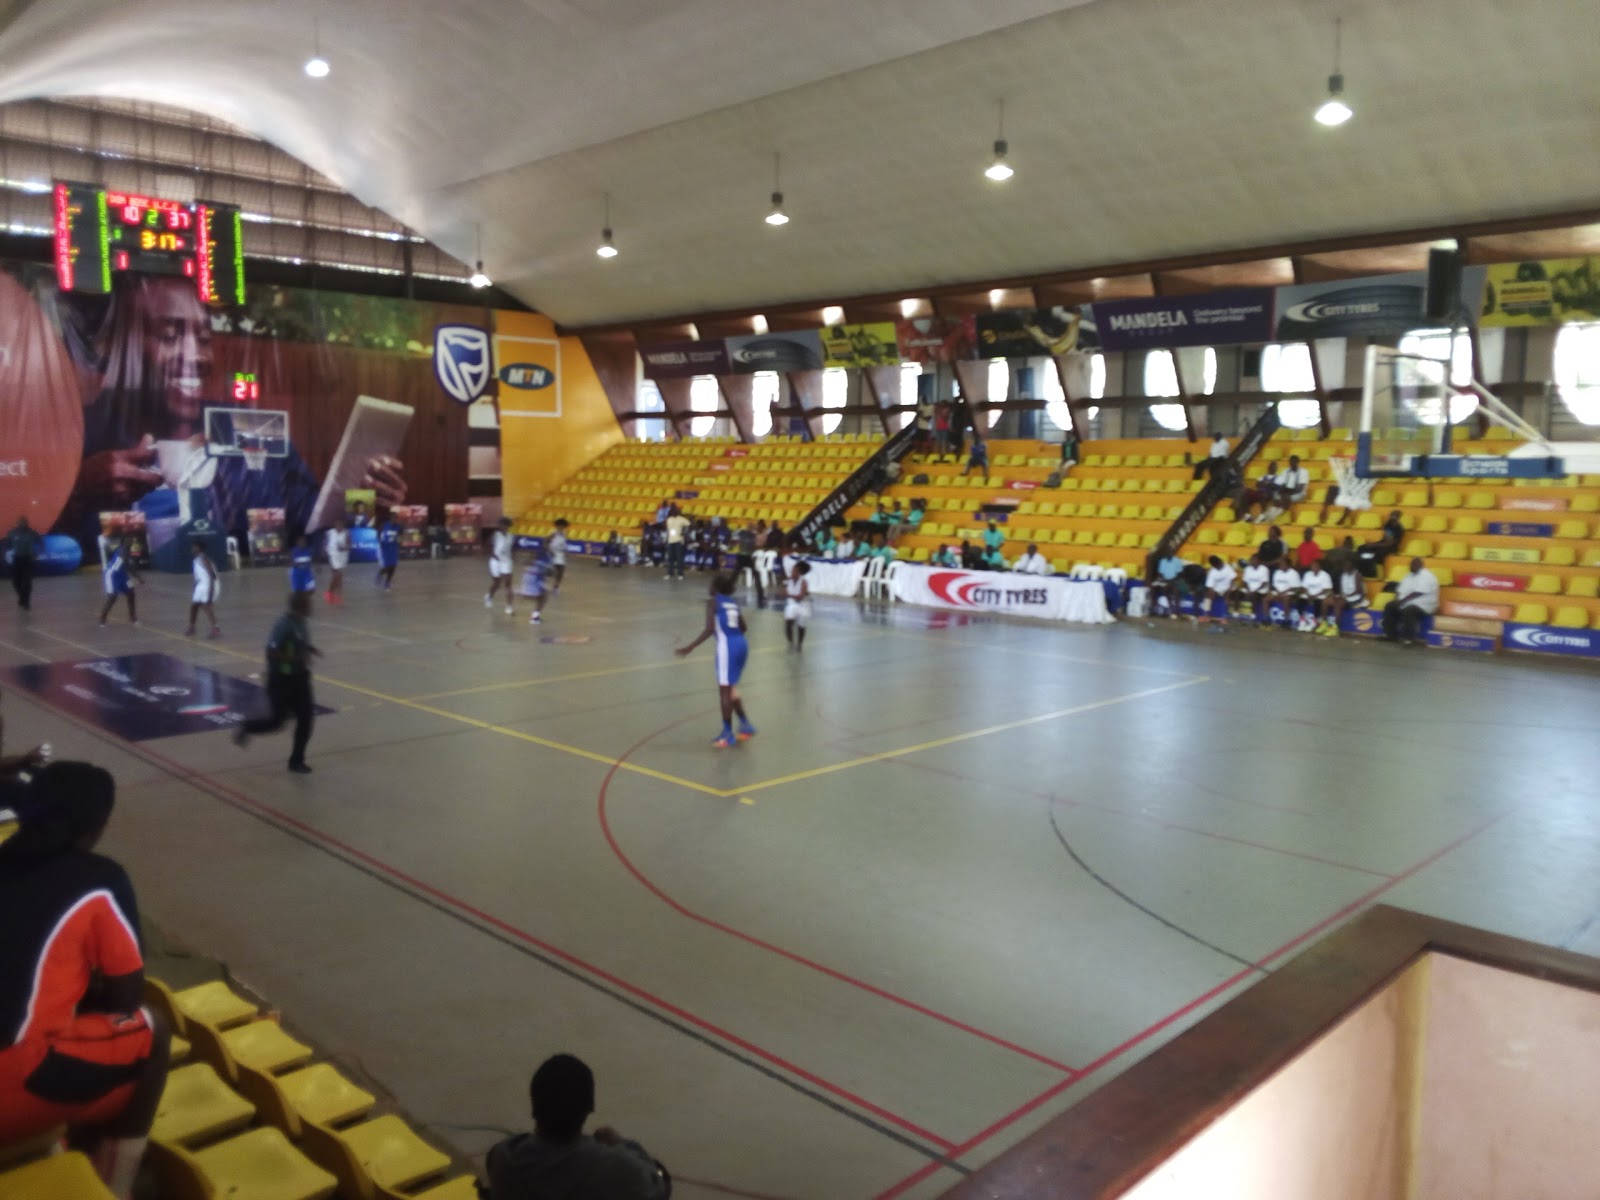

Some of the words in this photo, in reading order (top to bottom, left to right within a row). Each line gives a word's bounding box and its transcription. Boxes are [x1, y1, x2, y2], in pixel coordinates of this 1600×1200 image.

[168, 211, 191, 228] 37
[1109, 310, 1189, 331] MANDELA
[507, 367, 546, 386] MTN
[233, 381, 258, 400] 21
[973, 588, 1002, 605] CITY
[1006, 588, 1048, 605] TYRES
